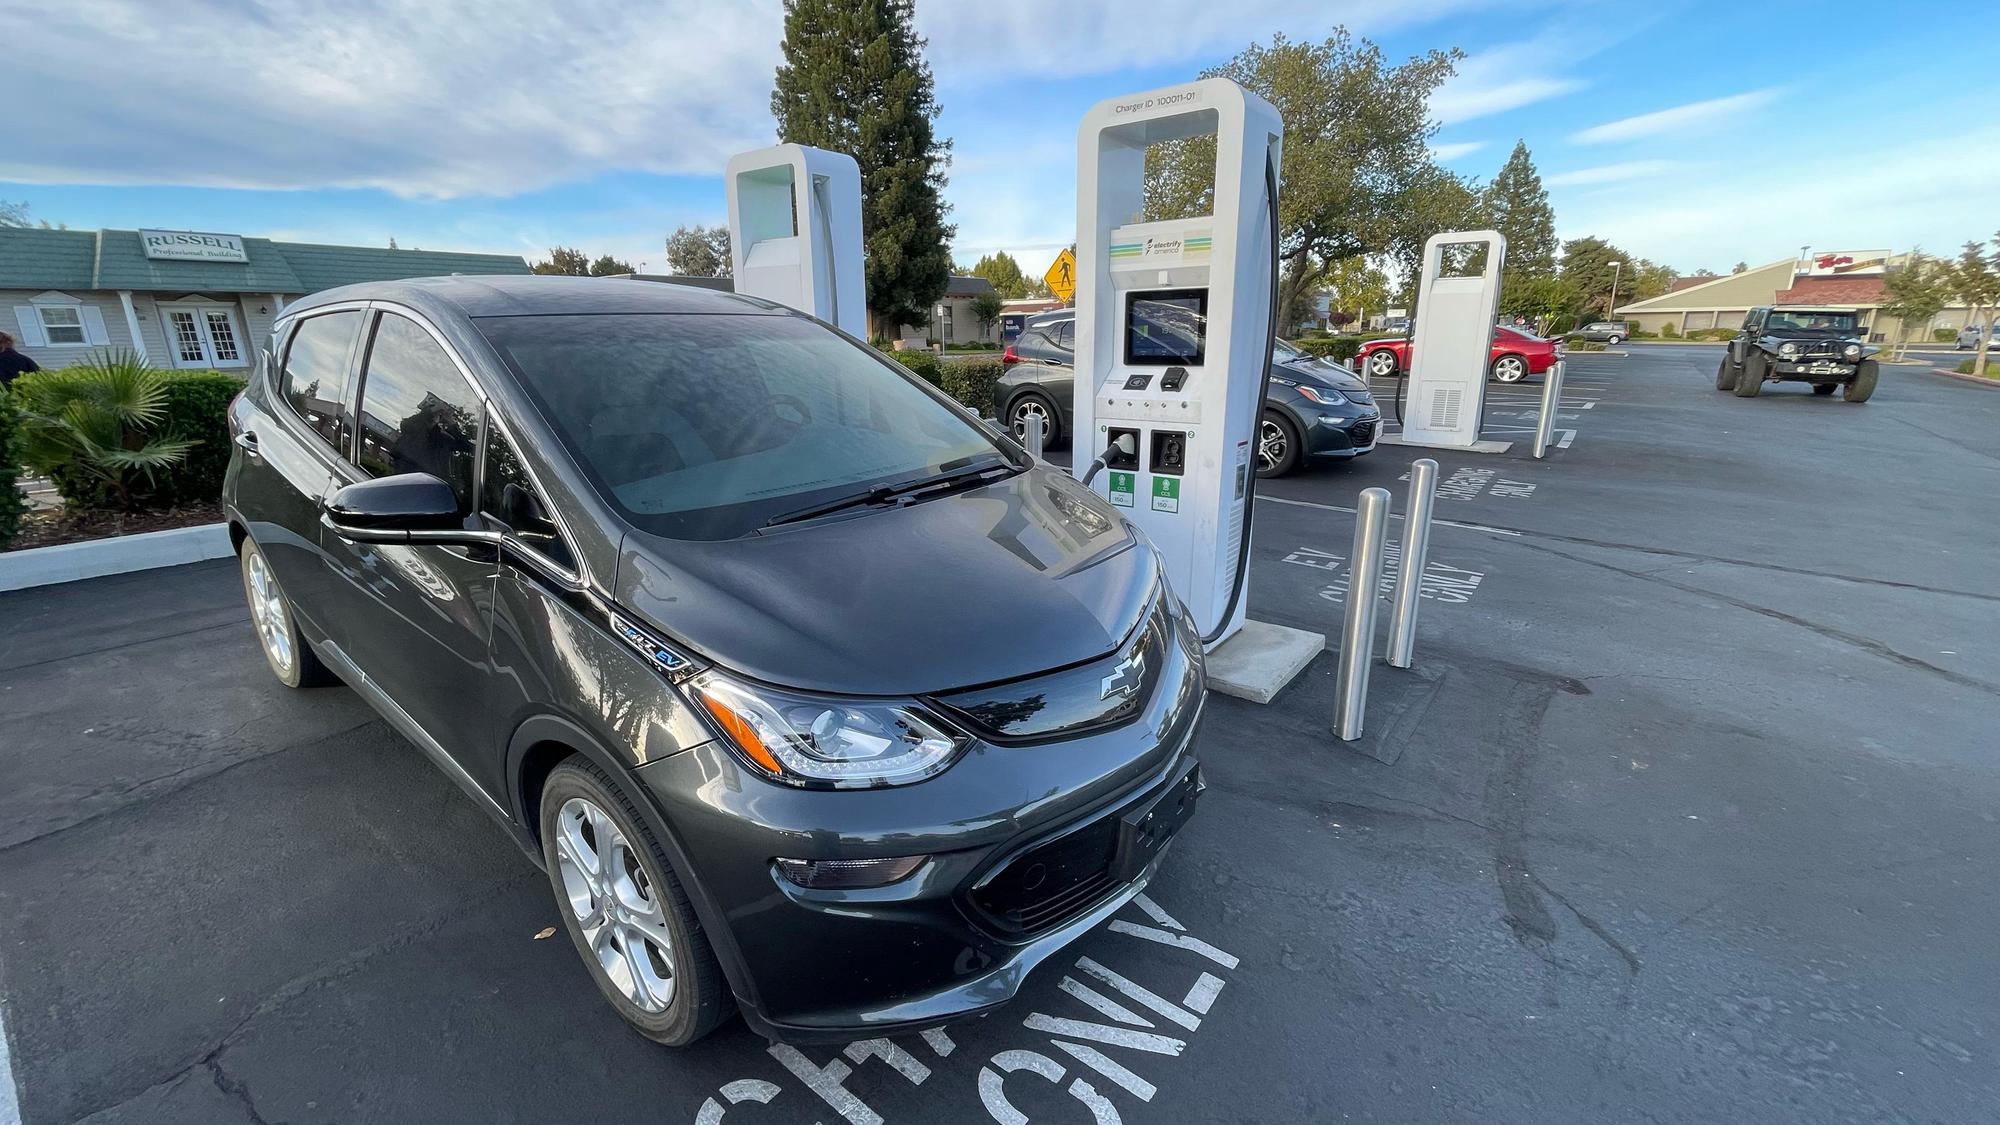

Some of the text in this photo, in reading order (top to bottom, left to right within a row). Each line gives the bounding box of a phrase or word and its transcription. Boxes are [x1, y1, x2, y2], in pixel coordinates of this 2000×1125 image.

[1115, 92, 1195, 113] Charger ID 100011-01
[147, 234, 241, 251] RUSSELL
[1154, 240, 1181, 249] electrify
[1282, 547, 1346, 570] EV
[656, 650, 680, 666] EV
[978, 893, 1239, 1125] ONLY
